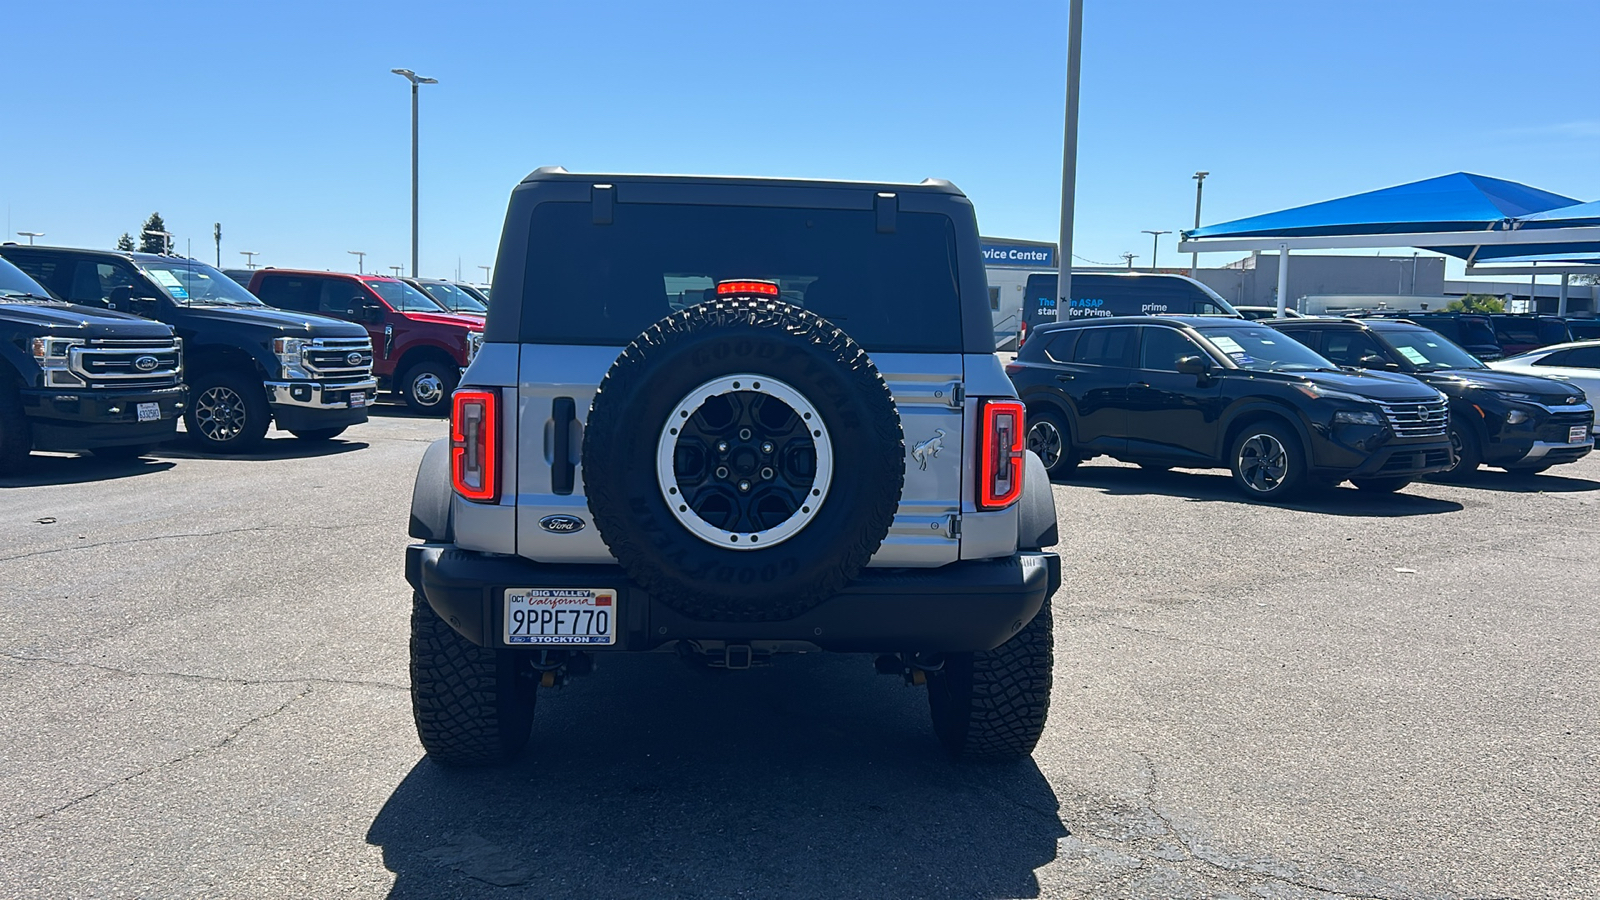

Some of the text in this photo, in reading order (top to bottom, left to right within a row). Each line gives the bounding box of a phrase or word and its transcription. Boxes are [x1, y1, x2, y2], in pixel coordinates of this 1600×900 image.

[982, 248, 1048, 261] vice Center
[1038, 297, 1055, 306] The
[1078, 298, 1104, 307] ASAP
[1141, 302, 1168, 312] prime
[1037, 307, 1057, 315] stan
[1069, 307, 1083, 316] for
[549, 518, 574, 530] Ford
[511, 595, 525, 603] OCT
[528, 597, 590, 609] California
[512, 609, 608, 635] 9PPF770
